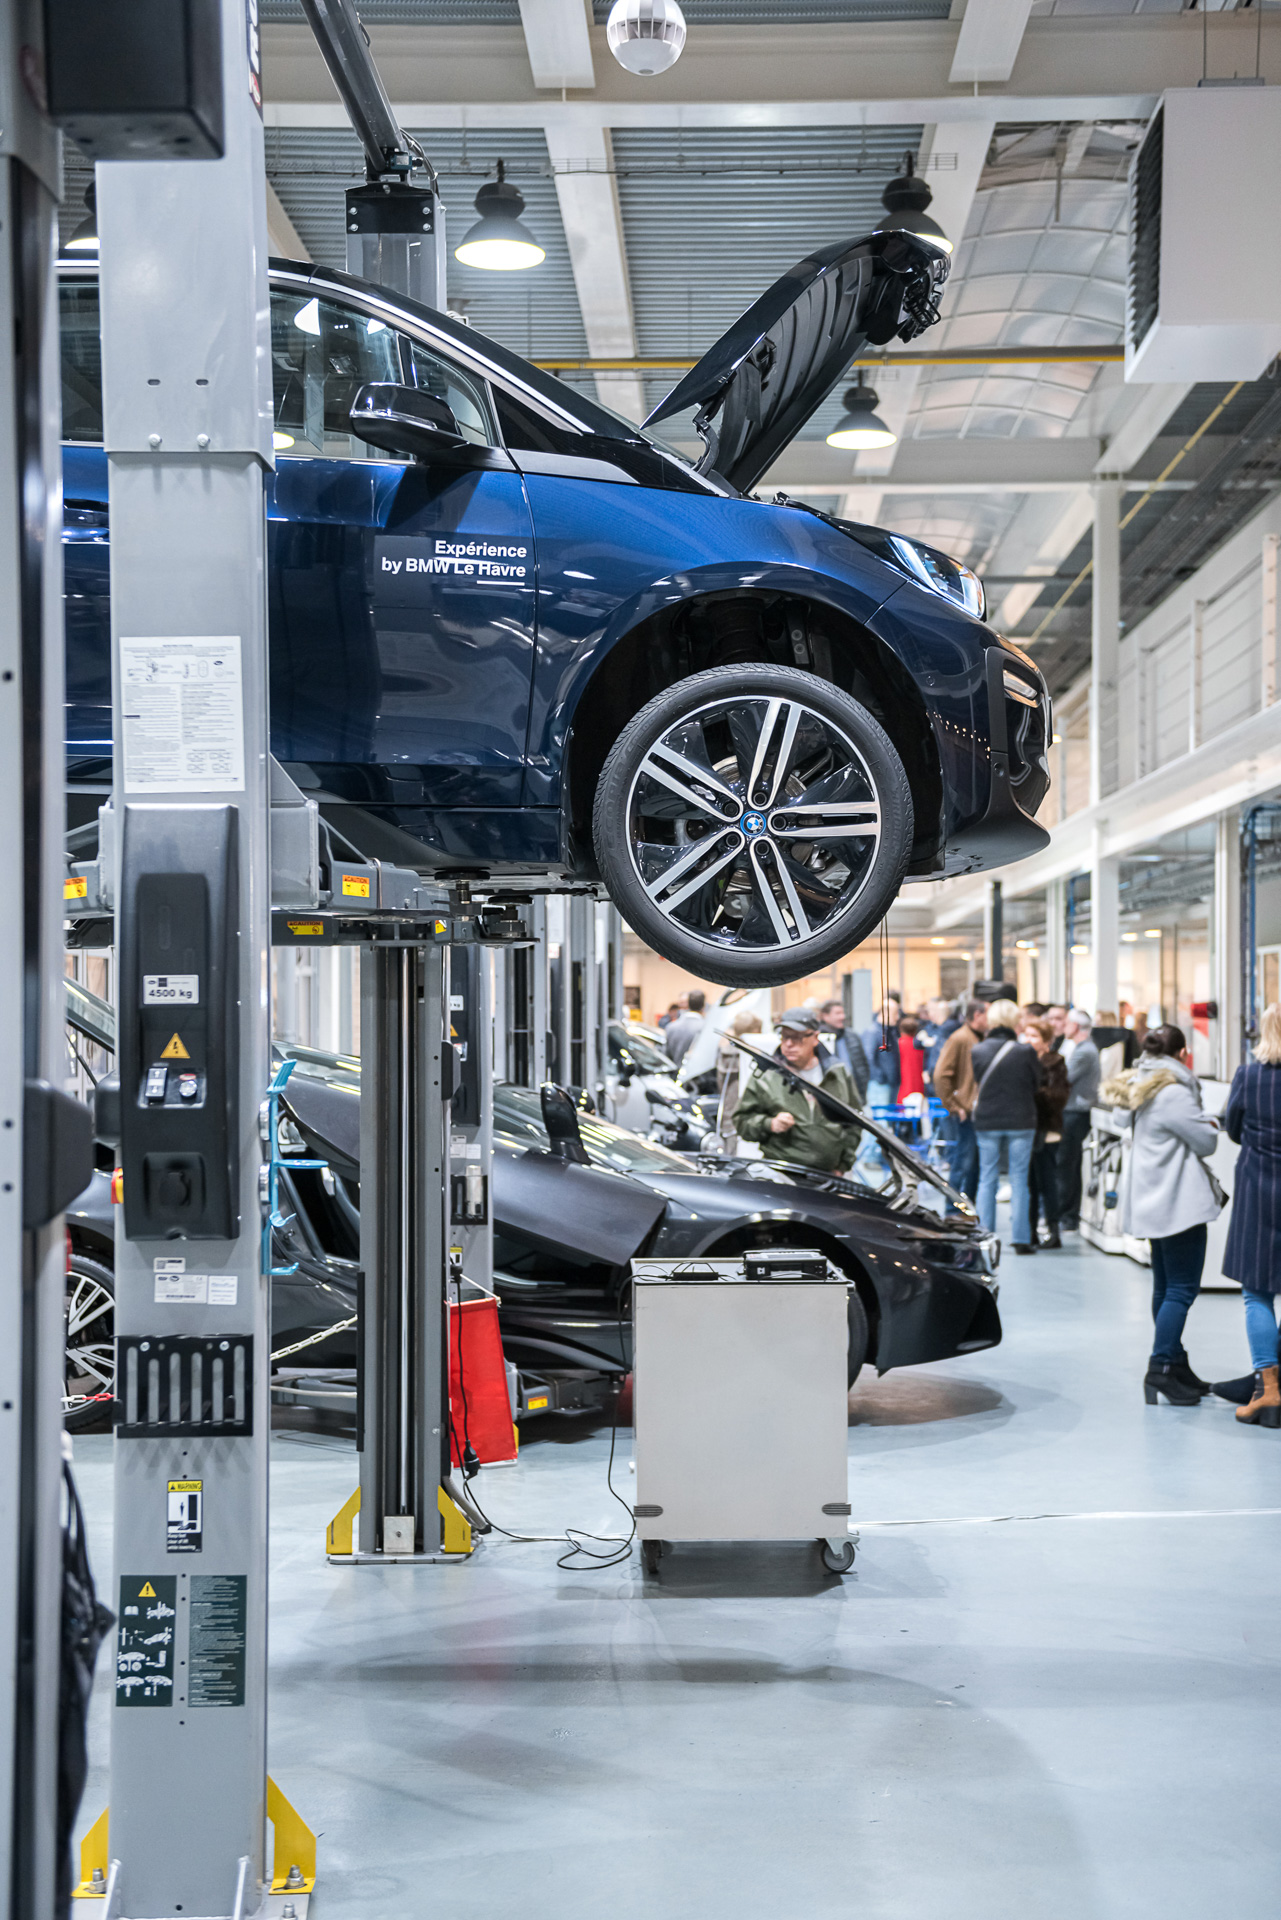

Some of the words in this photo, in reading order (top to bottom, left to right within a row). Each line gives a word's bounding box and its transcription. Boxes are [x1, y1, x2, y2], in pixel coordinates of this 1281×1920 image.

[435, 540, 527, 557] Expérience
[381, 557, 402, 574] by
[405, 558, 450, 573] BMW
[454, 562, 474, 575] Le
[478, 563, 526, 577] Havre
[148, 989, 175, 998] 4500
[179, 989, 193, 999] kg
[177, 1482, 202, 1490] WARNING
